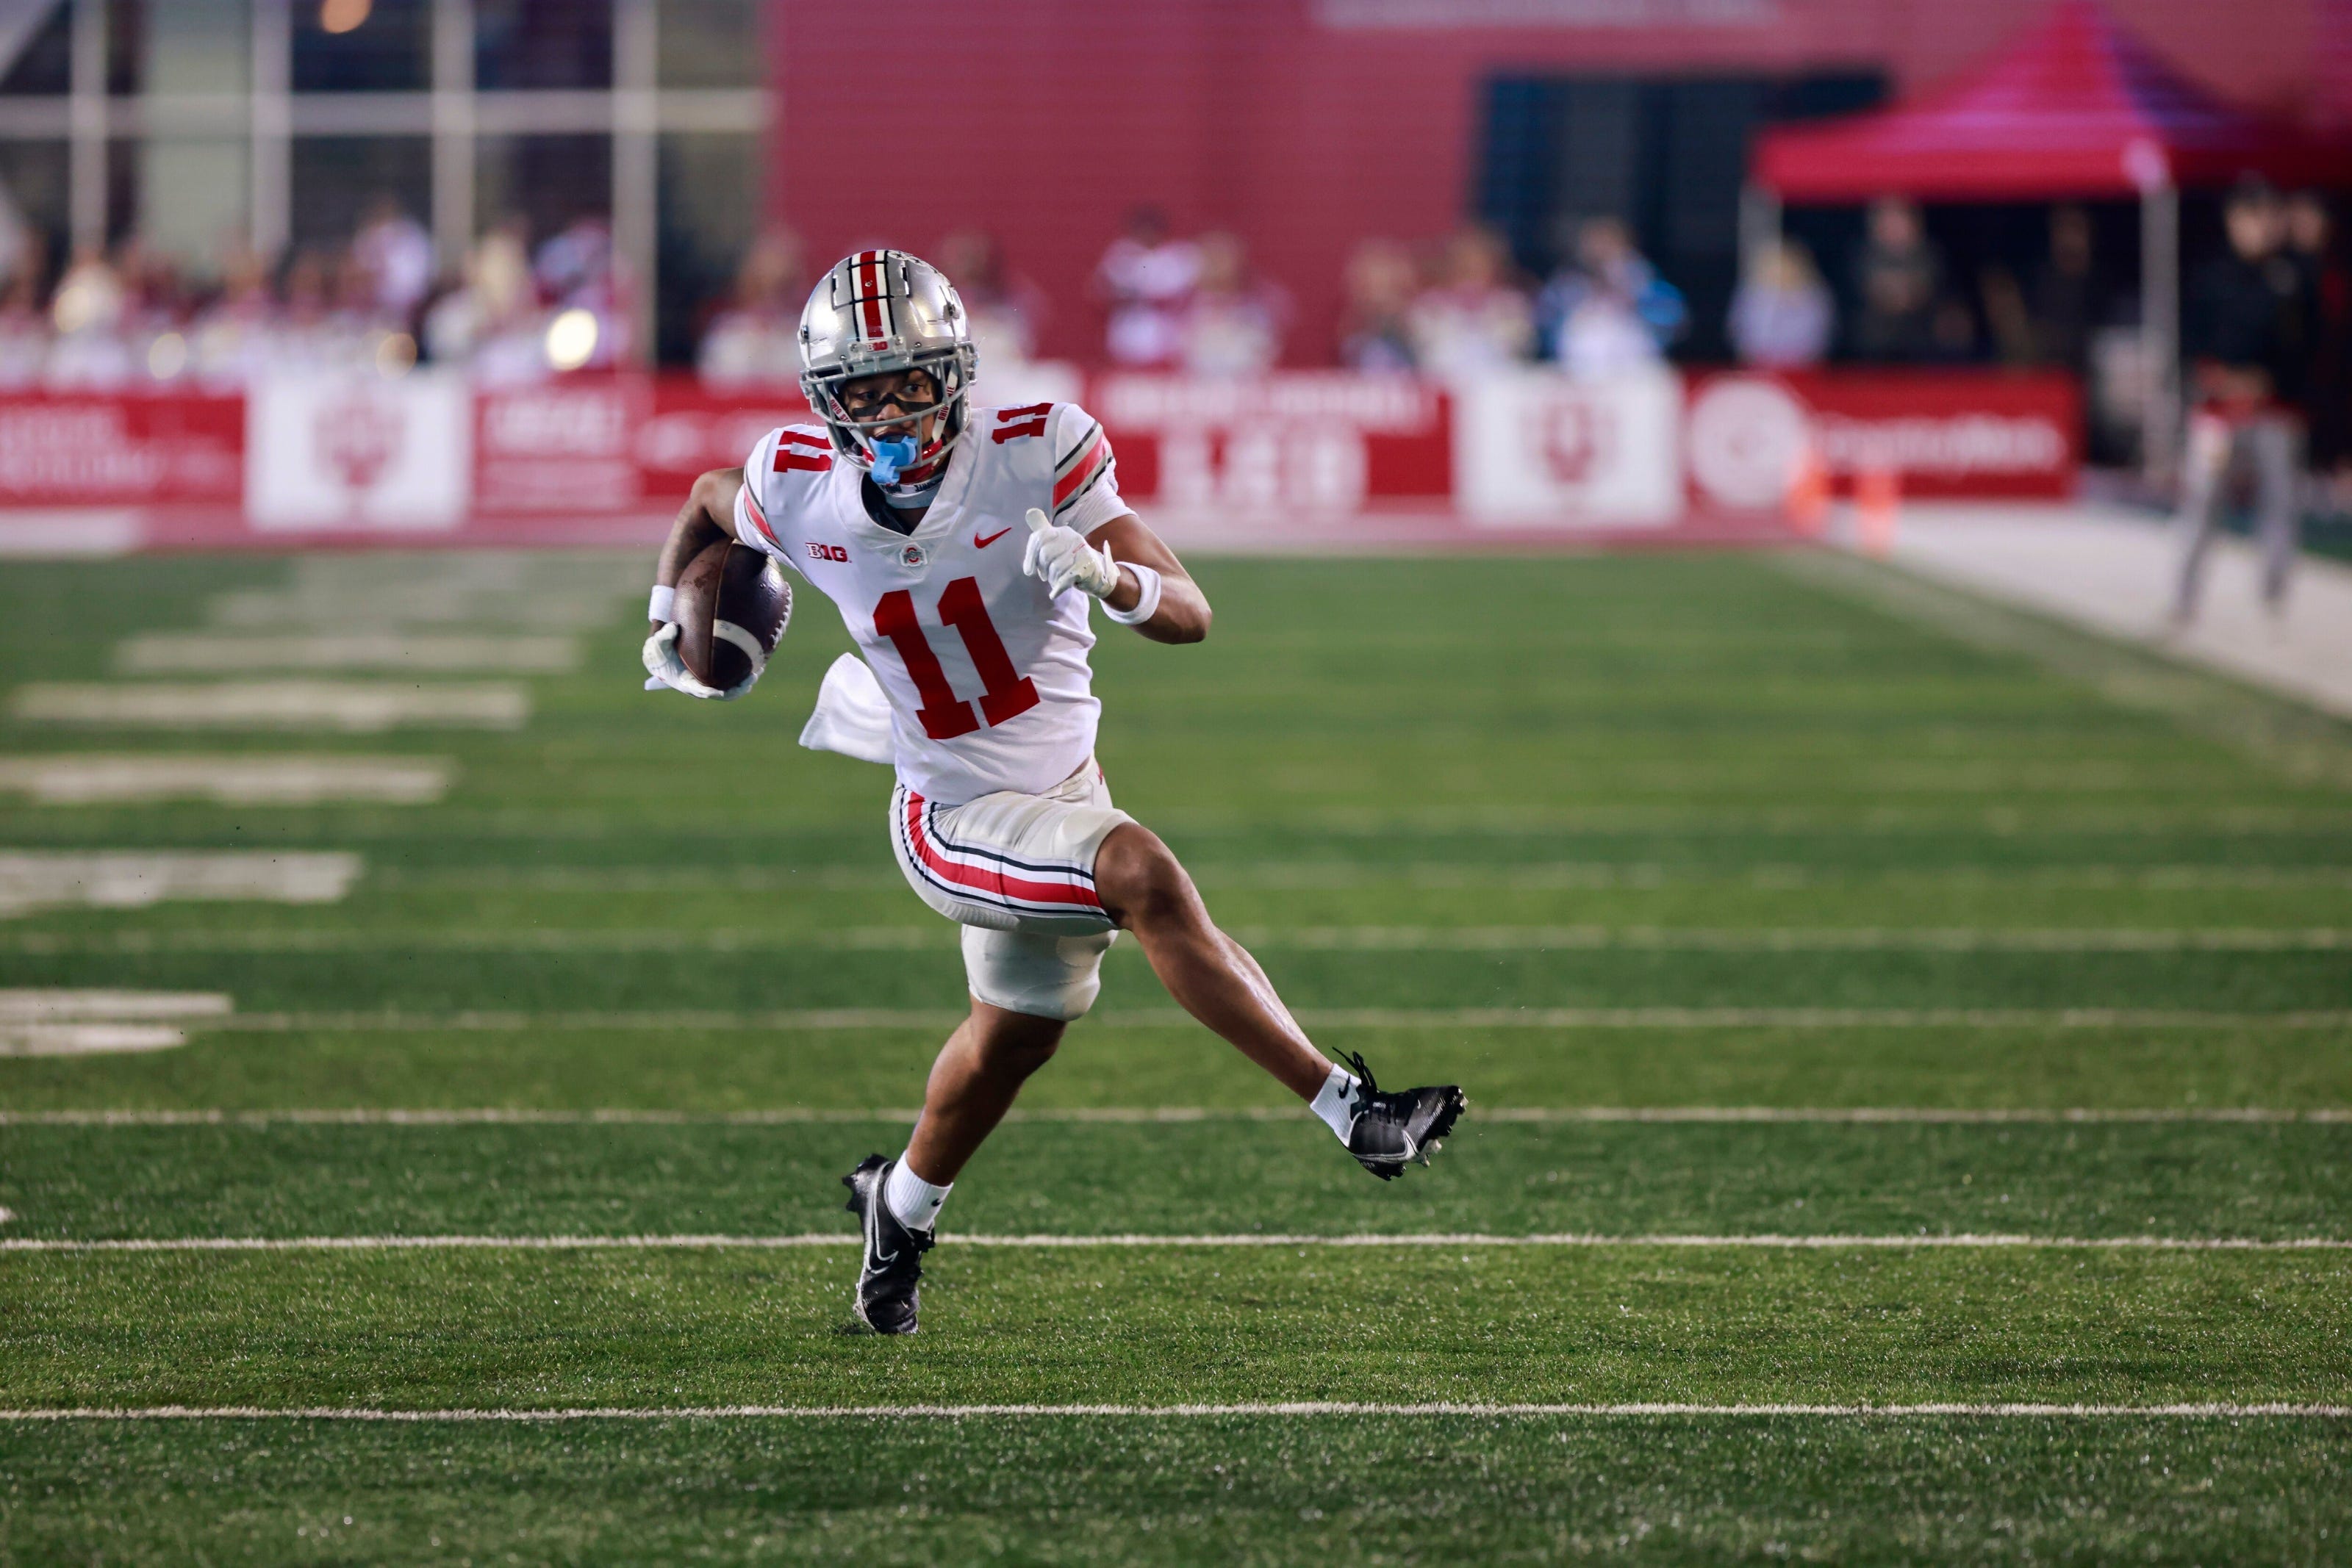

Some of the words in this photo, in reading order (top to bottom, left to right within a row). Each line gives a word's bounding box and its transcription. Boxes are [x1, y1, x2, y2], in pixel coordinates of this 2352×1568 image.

[992, 402, 1055, 445] 11
[772, 431, 833, 473] 11
[872, 575, 1041, 740] 11
